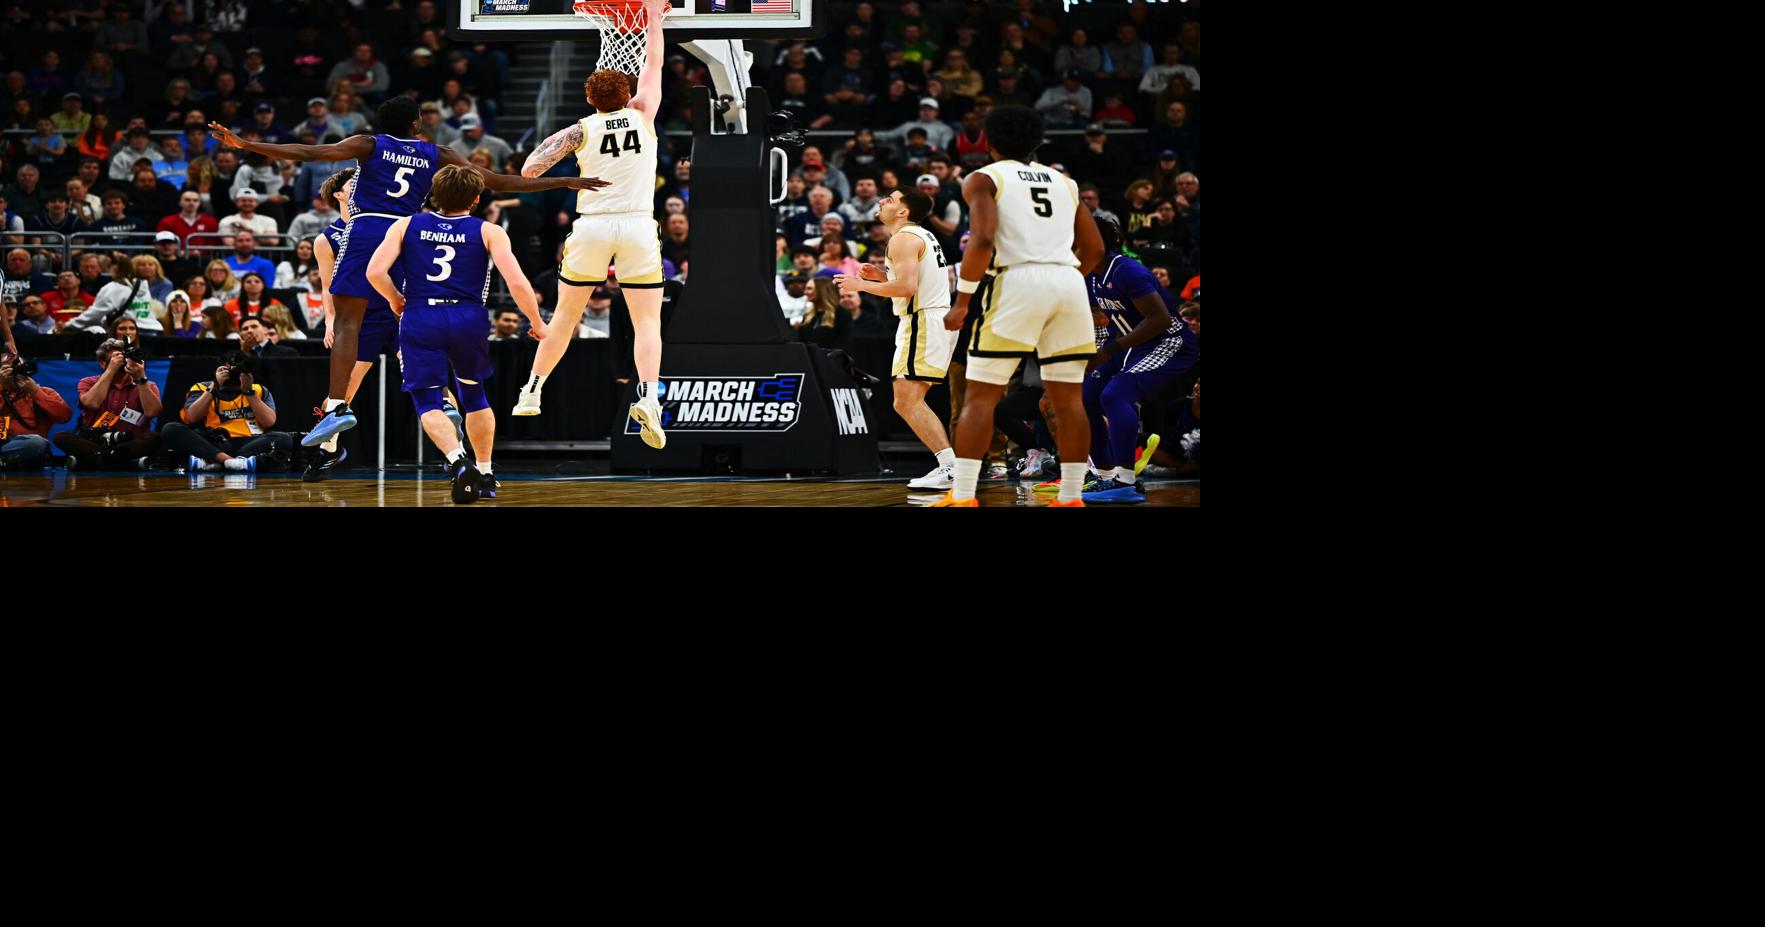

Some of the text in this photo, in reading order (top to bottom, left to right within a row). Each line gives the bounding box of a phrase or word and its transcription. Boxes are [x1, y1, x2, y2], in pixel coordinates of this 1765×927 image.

[605, 118, 630, 130] BERG
[600, 130, 641, 157] 44
[382, 150, 430, 169] HAMILTON
[386, 166, 416, 198] 5
[1017, 170, 1052, 183] COLVIN
[1030, 187, 1053, 218] 5
[420, 230, 466, 243] BENHAM
[426, 244, 456, 282] 3
[1111, 314, 1133, 336] 11
[667, 381, 755, 401] MARCH
[677, 402, 796, 422] MADNESS
[830, 388, 868, 435] NCAA
